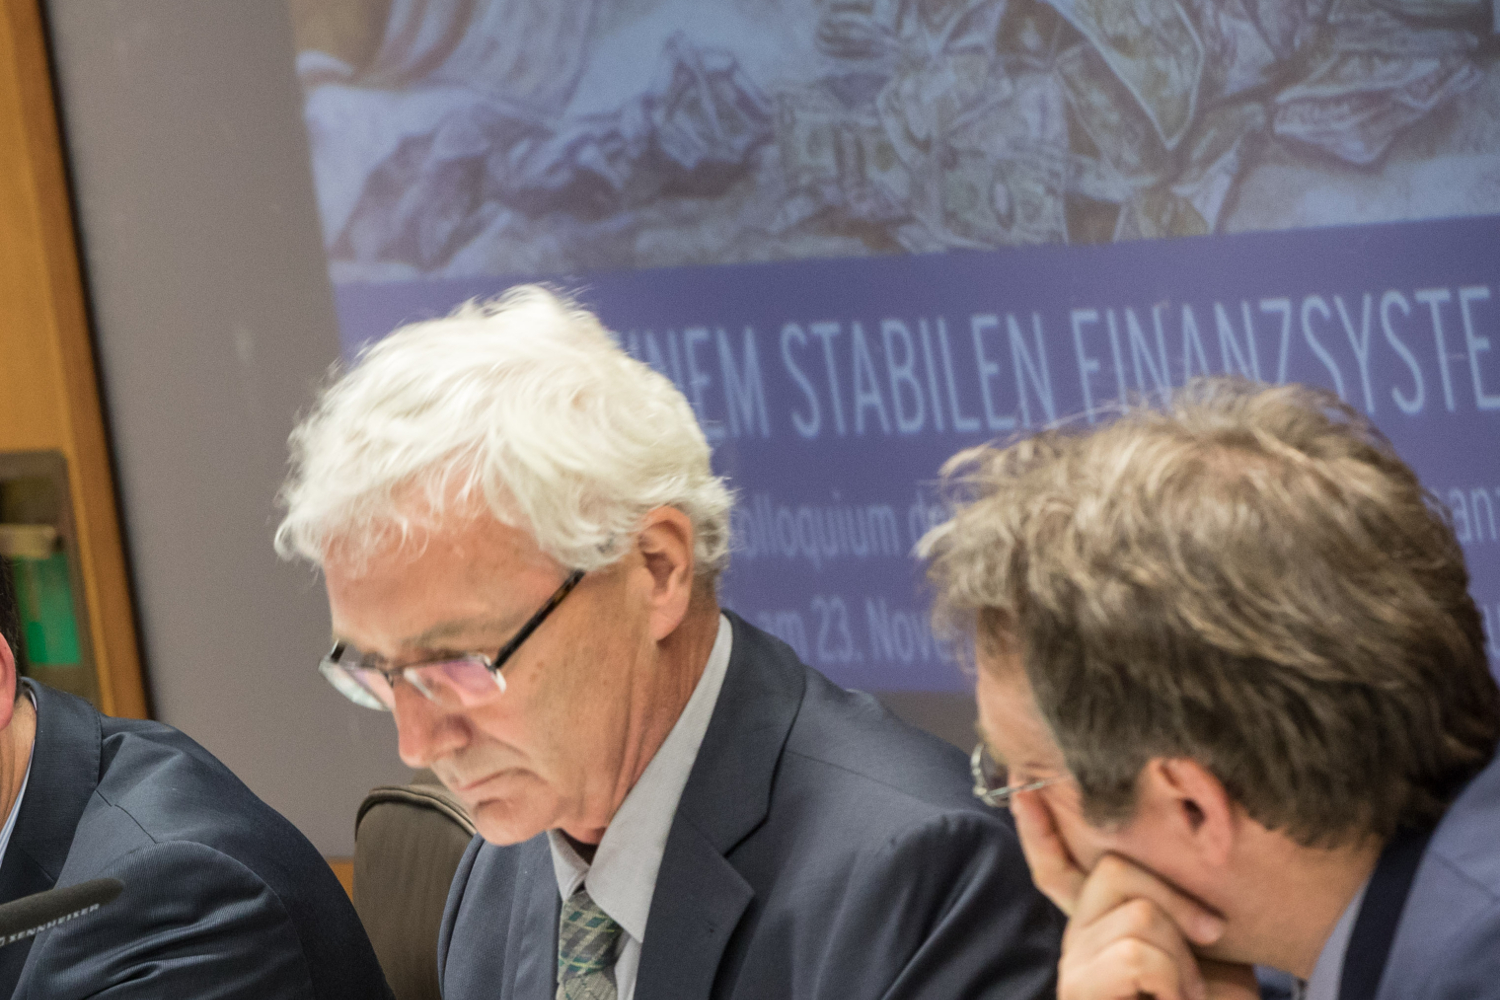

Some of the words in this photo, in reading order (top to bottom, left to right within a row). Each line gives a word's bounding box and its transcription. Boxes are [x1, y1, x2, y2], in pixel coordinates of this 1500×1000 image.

[609, 324, 770, 440] NEM
[780, 311, 1058, 438] STABILEN
[811, 594, 865, 664] 23.
